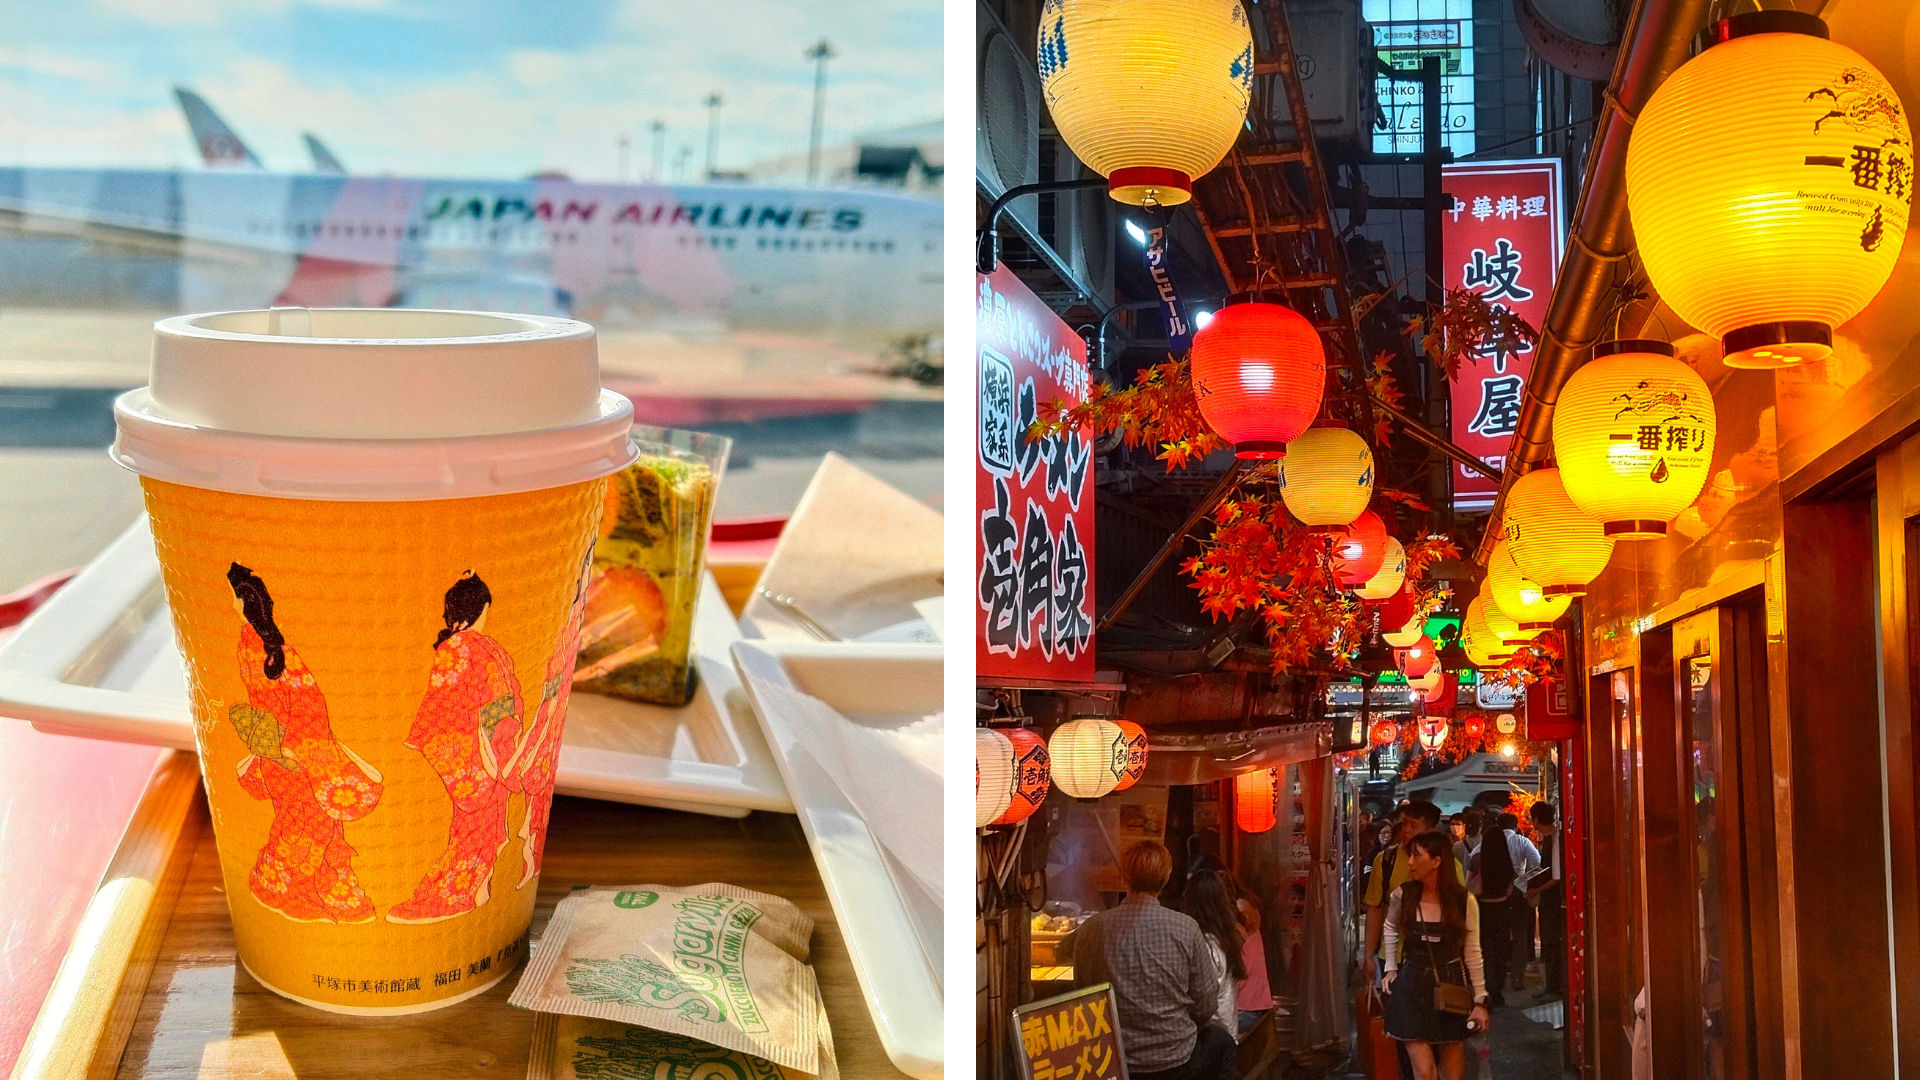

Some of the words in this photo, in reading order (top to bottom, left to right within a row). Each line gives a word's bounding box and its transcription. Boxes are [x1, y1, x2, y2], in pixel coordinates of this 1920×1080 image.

[1441, 85, 1454, 94] OT
[1387, 135, 1424, 144] SHINJU
[1804, 145, 1913, 204] 一番搾
[428, 197, 597, 223] JAPAN
[611, 202, 866, 233] AIRLINES
[1448, 195, 1548, 223] 中華料理
[1146, 227, 1186, 337] アサヒビール
[1609, 425, 1706, 453] 一番搾り
[979, 478, 1093, 662] 壱角家
[1130, 750, 1149, 765] 壱角
[1024, 766, 1051, 786] 壱角
[722, 930, 743, 963] CANNA
[312, 973, 421, 994] 平塚市美術館蔵
[433, 968, 462, 987] 福田
[726, 975, 761, 1026] ZUCCHERO
[1021, 997, 1113, 1059] 赤MAX
